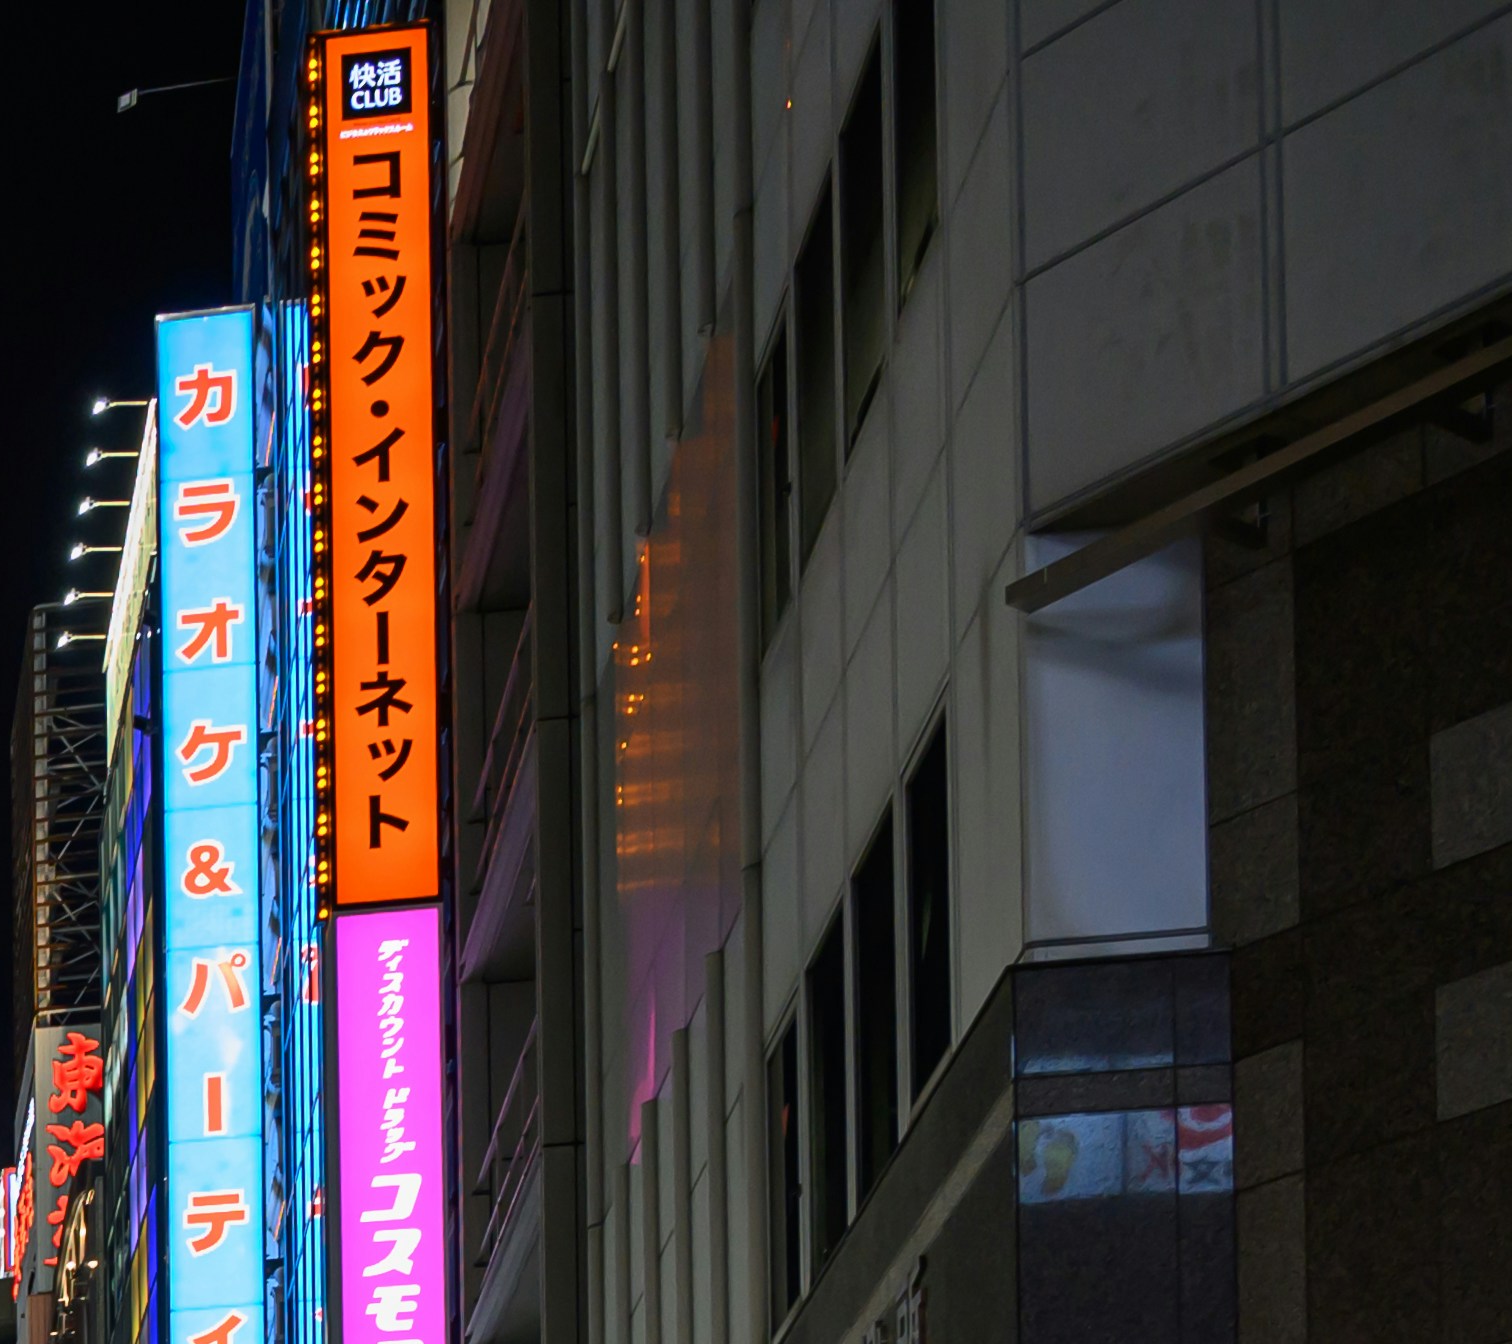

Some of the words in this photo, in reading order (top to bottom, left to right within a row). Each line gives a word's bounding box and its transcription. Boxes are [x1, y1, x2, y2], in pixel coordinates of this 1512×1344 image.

[348, 60, 402, 90] 快活
[350, 86, 403, 110] CLUB
[351, 148, 412, 851] コミック・インターネット
[377, 938, 411, 1081] ディスカウント
[379, 1085, 418, 1165] ドラッグ
